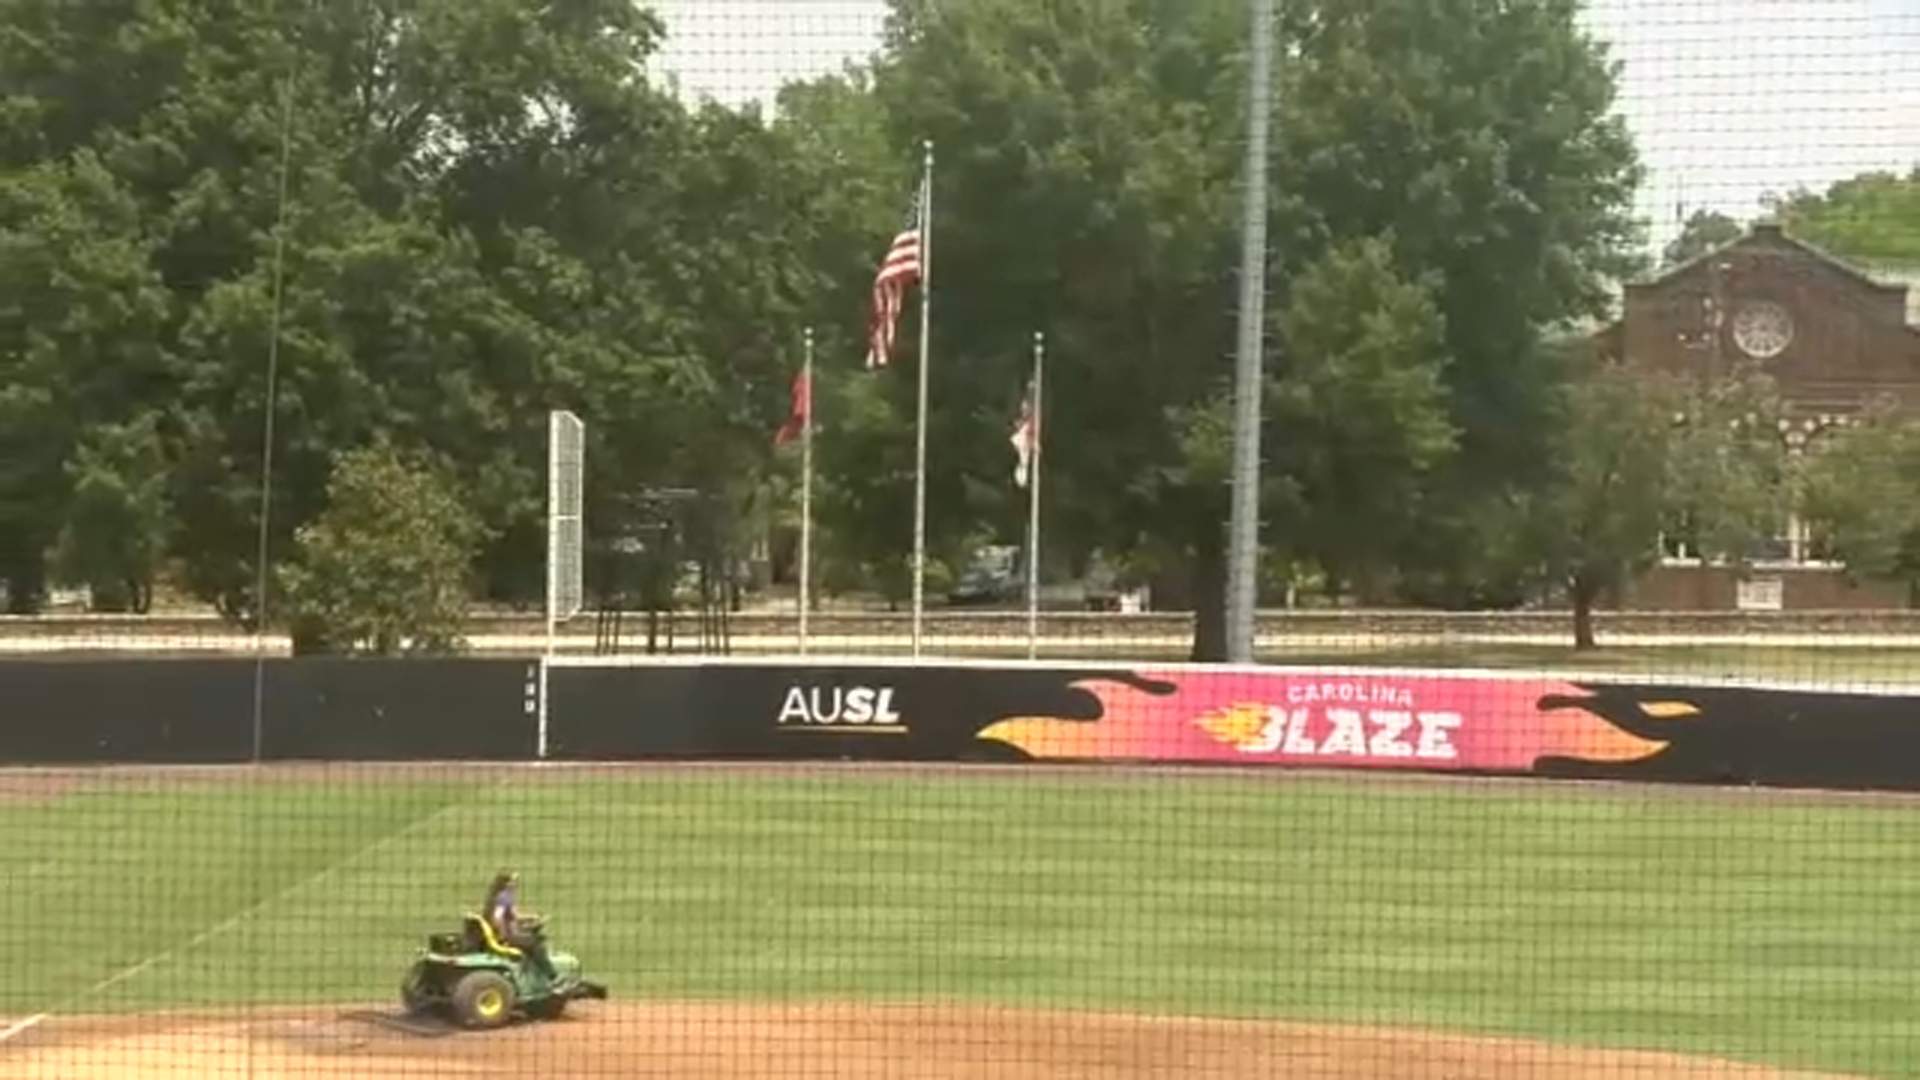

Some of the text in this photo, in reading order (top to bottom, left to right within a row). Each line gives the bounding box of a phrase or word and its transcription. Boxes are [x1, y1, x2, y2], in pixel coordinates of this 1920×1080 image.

[777, 686, 901, 724] AUSL
[1287, 683, 1413, 706] CAROLINA
[1236, 705, 1462, 758] BLAZE
